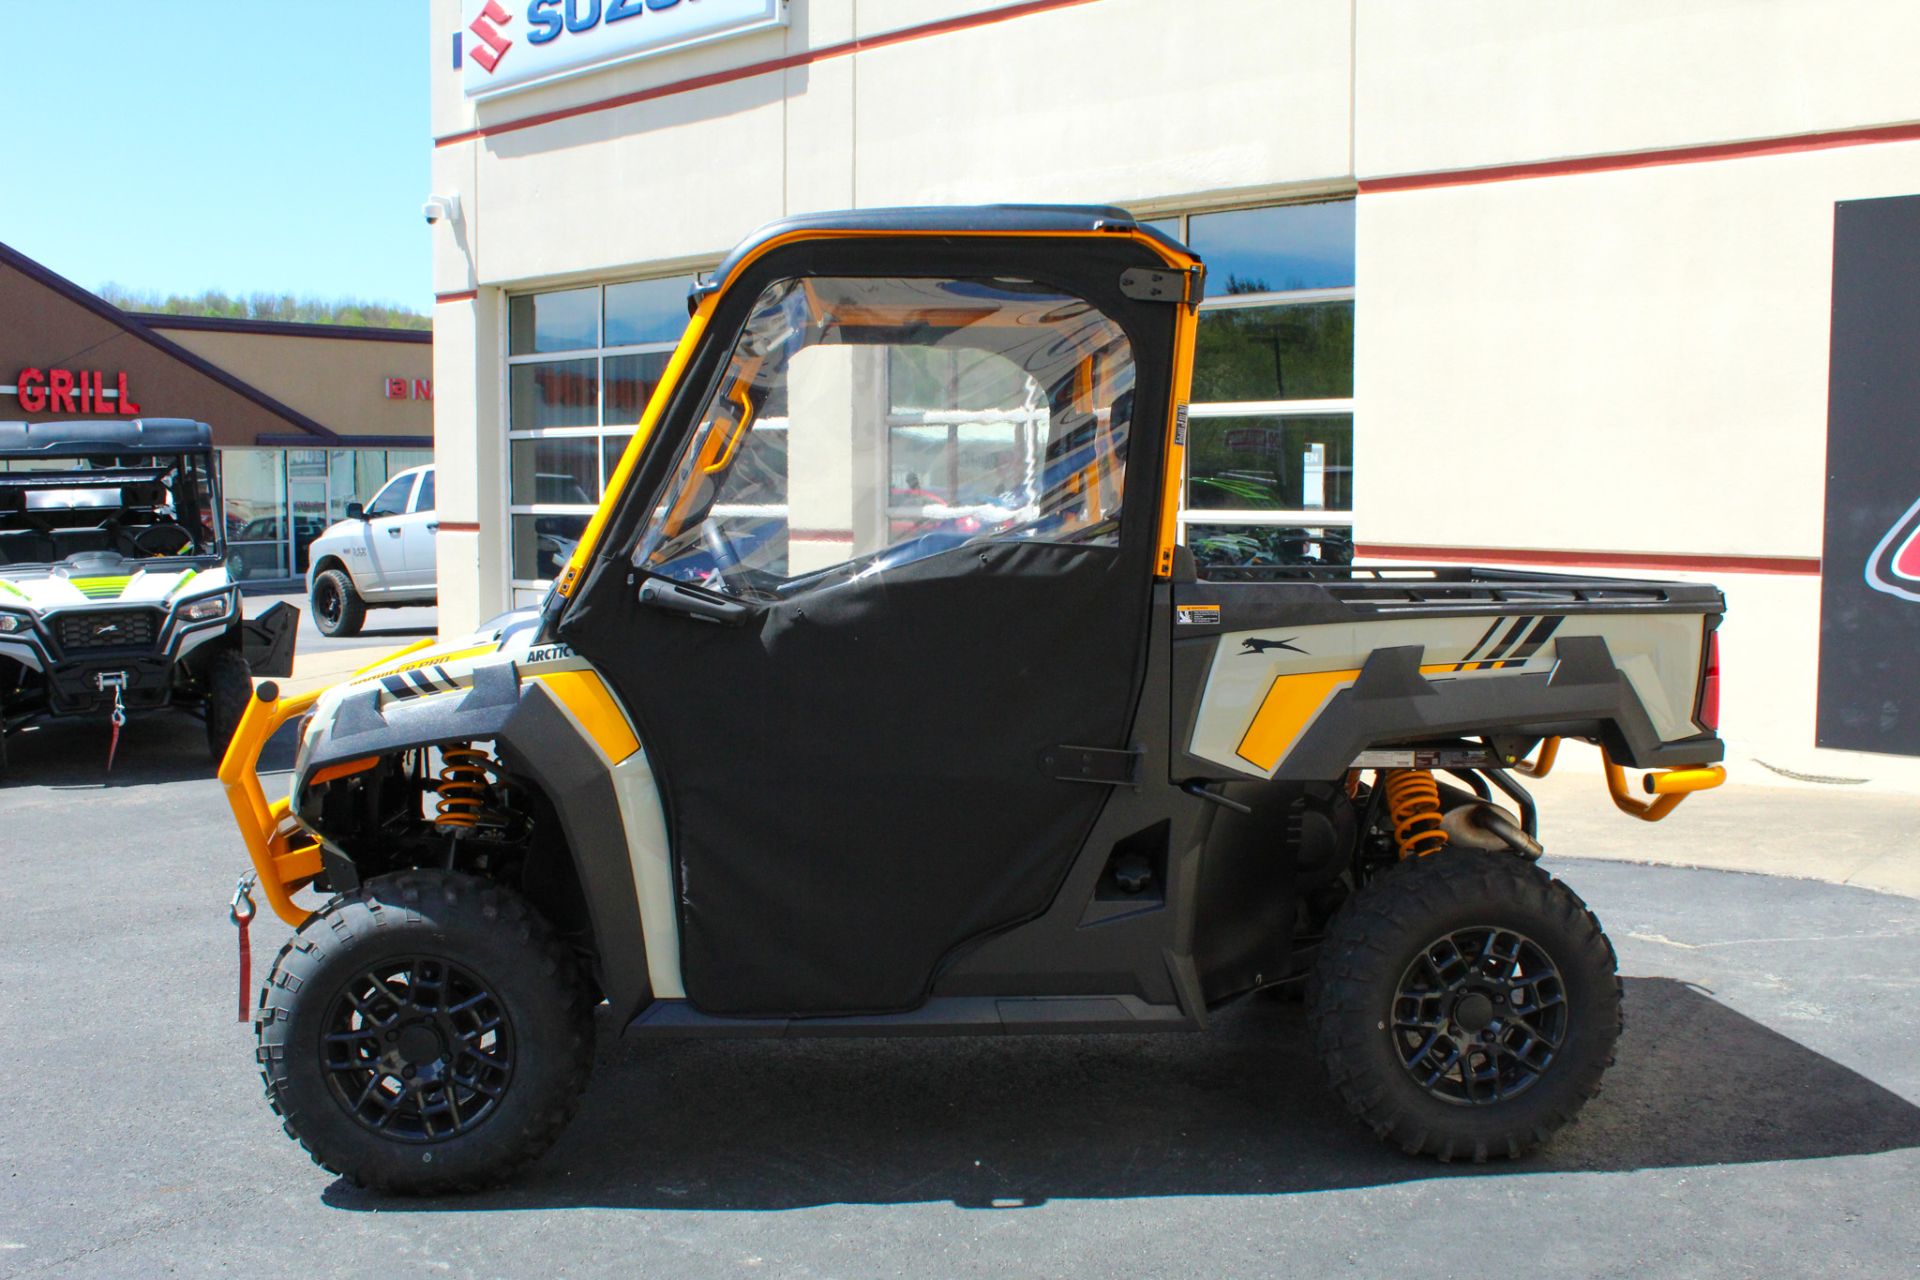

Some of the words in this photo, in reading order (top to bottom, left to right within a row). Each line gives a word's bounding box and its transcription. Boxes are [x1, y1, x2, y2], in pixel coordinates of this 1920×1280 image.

[17, 367, 140, 414] GRILL
[411, 379, 434, 400] N
[527, 646, 570, 663] ARCTIC
